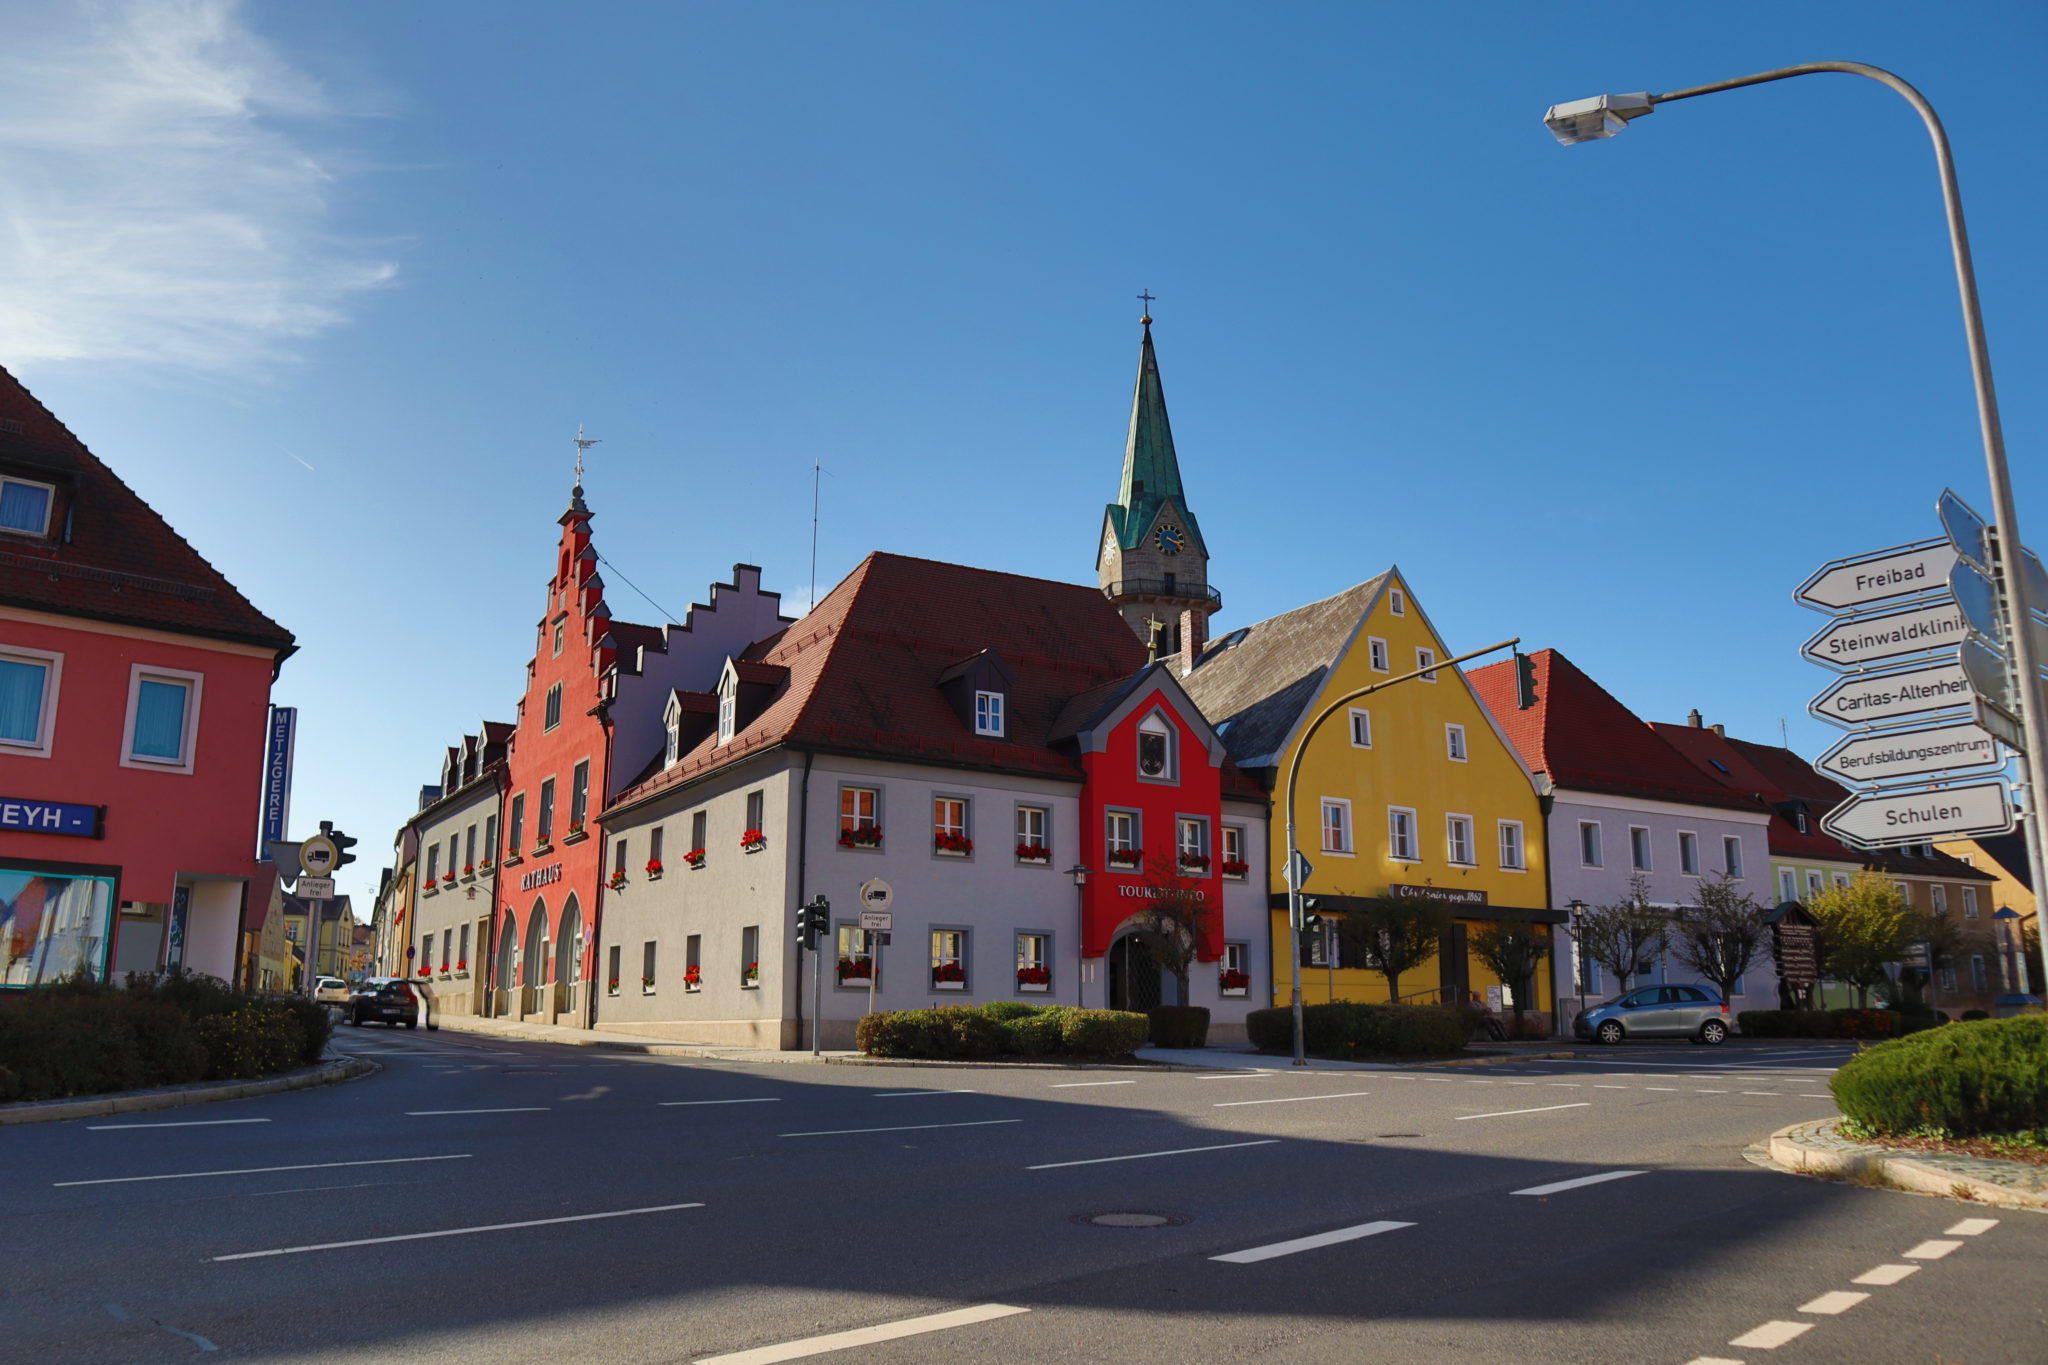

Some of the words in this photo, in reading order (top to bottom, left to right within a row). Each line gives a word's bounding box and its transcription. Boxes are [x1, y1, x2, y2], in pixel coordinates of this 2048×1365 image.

[1856, 563, 1926, 591] Freibad
[1839, 738, 1990, 769] Berufsbildungszentrum
[269, 711, 287, 834] METZGEREI
[0, 803, 62, 829] EYH
[1885, 805, 1963, 826] Schulen
[301, 880, 331, 889] Anlieger
[521, 861, 561, 891] RATHAUS
[864, 914, 889, 922] Anlieger
